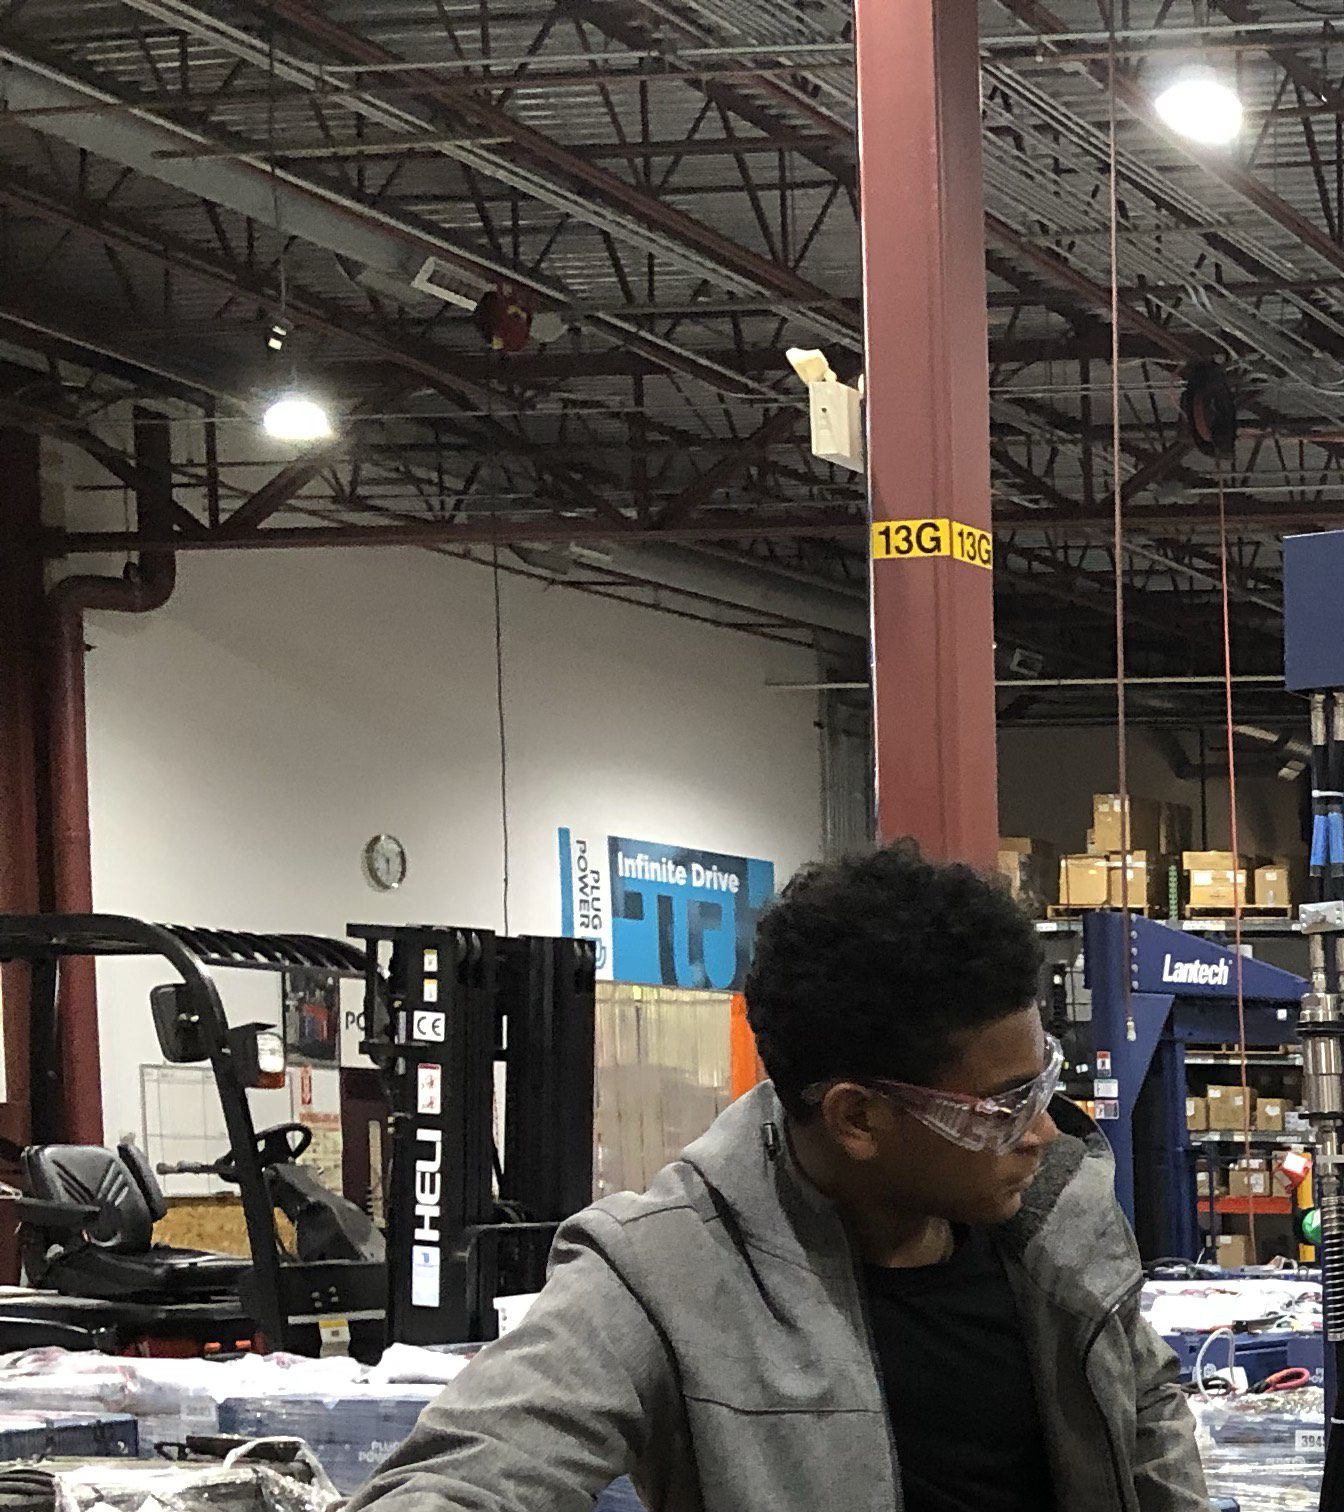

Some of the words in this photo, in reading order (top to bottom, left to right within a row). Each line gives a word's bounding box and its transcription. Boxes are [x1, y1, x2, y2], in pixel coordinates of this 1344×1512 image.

[878, 522, 942, 555] 13G
[958, 527, 992, 566] 13G
[575, 839, 591, 930] POWER
[617, 851, 688, 886] Infinite
[691, 863, 741, 894] Drive
[589, 869, 603, 931] PLUG
[1162, 953, 1230, 986] Lantech
[417, 1016, 442, 1037] CE
[414, 1128, 442, 1242] HELI
[1301, 1435, 1325, 1448] 394
